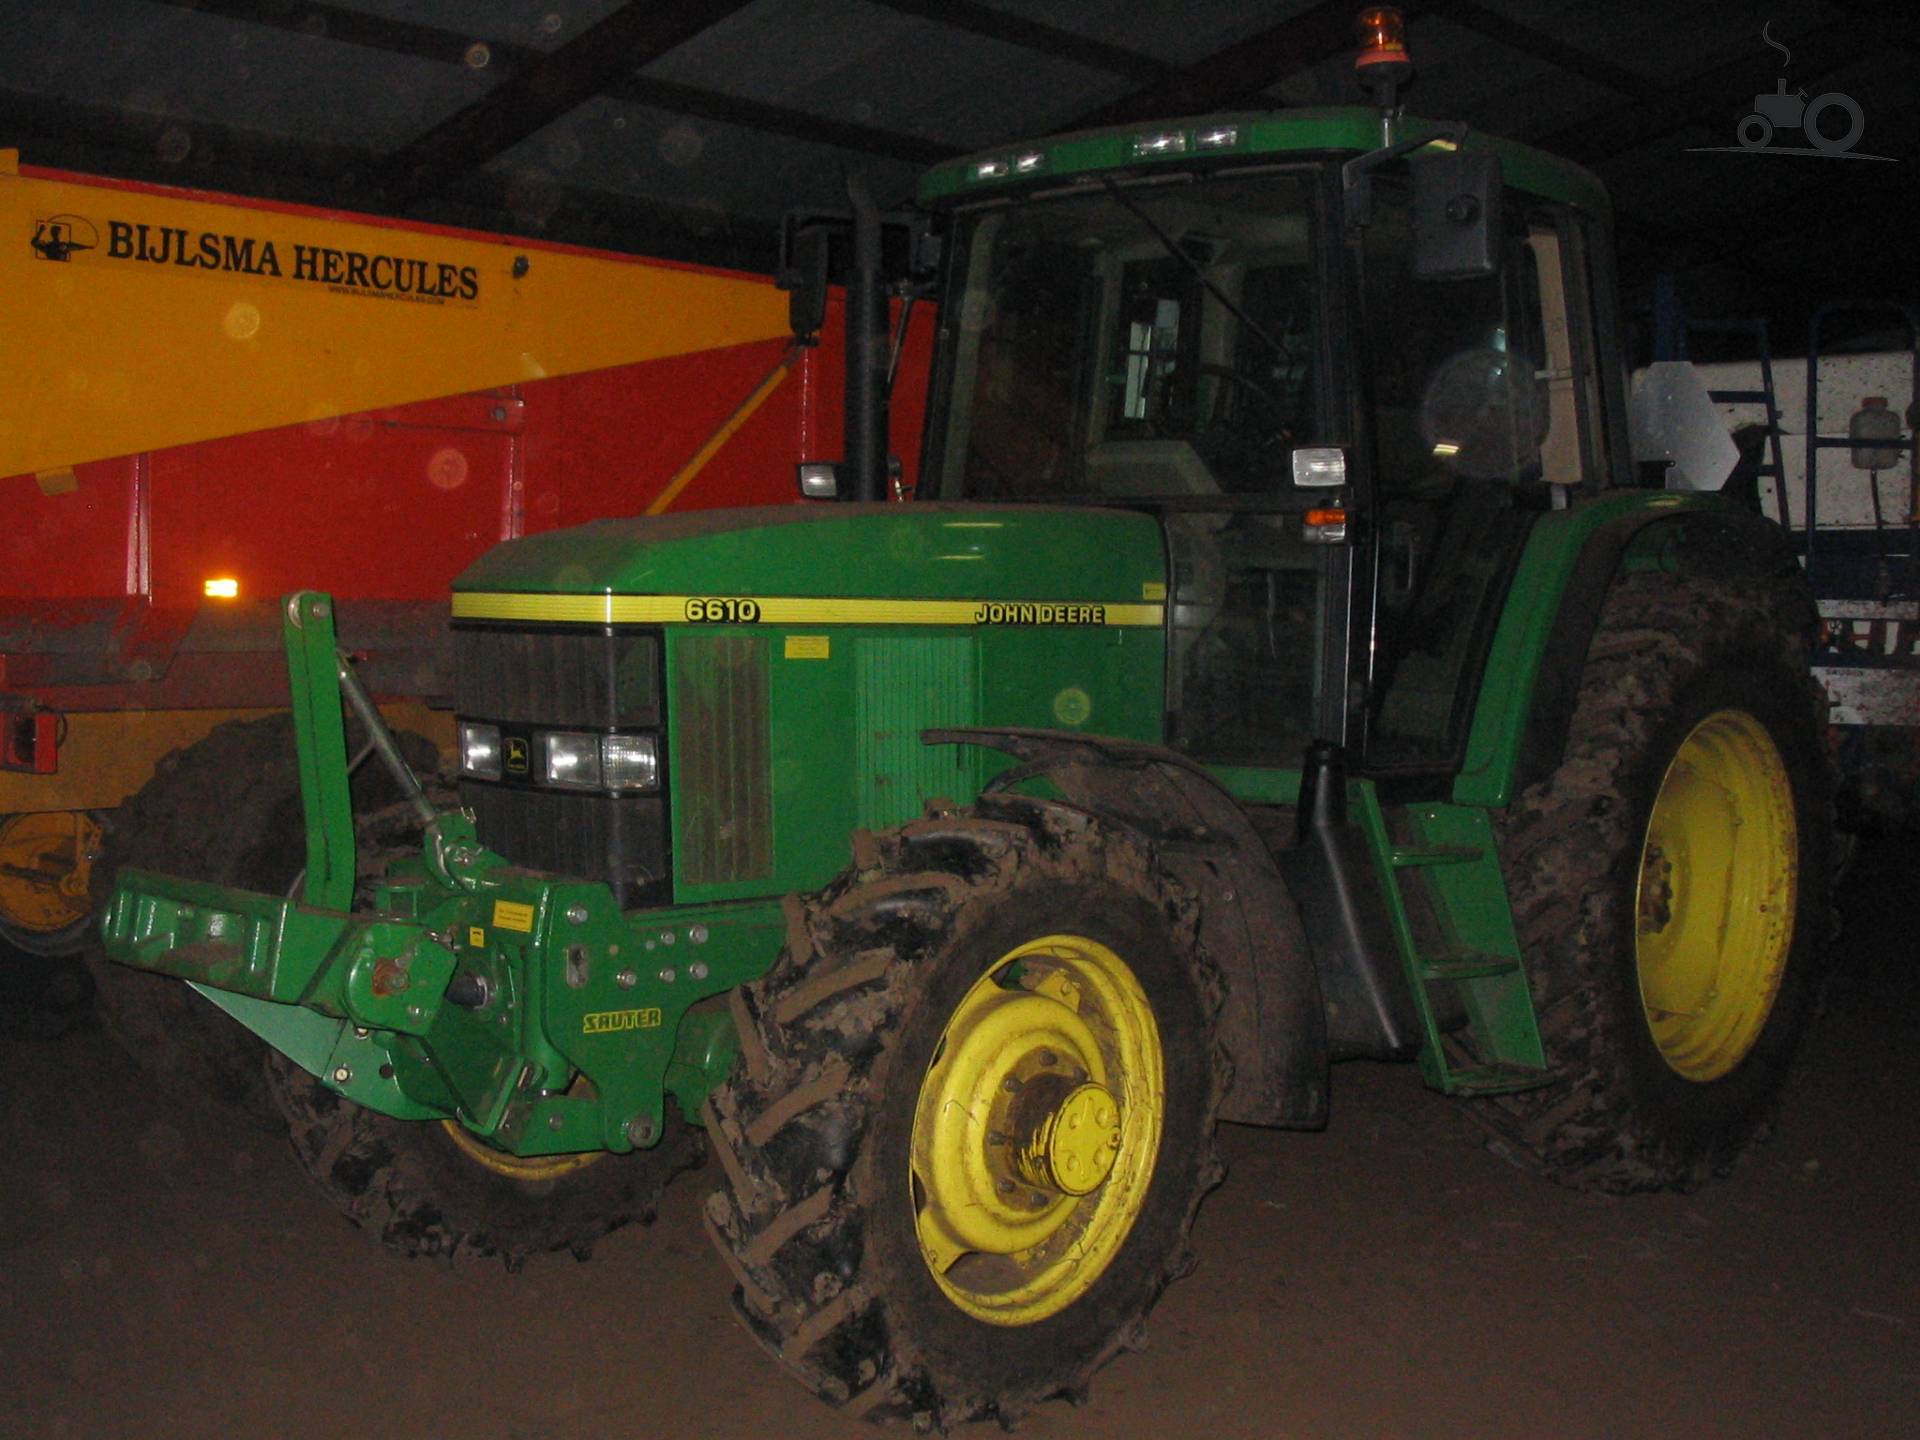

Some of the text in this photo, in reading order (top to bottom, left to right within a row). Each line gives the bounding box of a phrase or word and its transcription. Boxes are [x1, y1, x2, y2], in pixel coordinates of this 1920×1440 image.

[107, 220, 479, 301] BIJLSMA HERCULES
[685, 598, 761, 623] 6610
[974, 603, 1106, 625] JOHN DEERE
[583, 1007, 662, 1033] SAUTER
